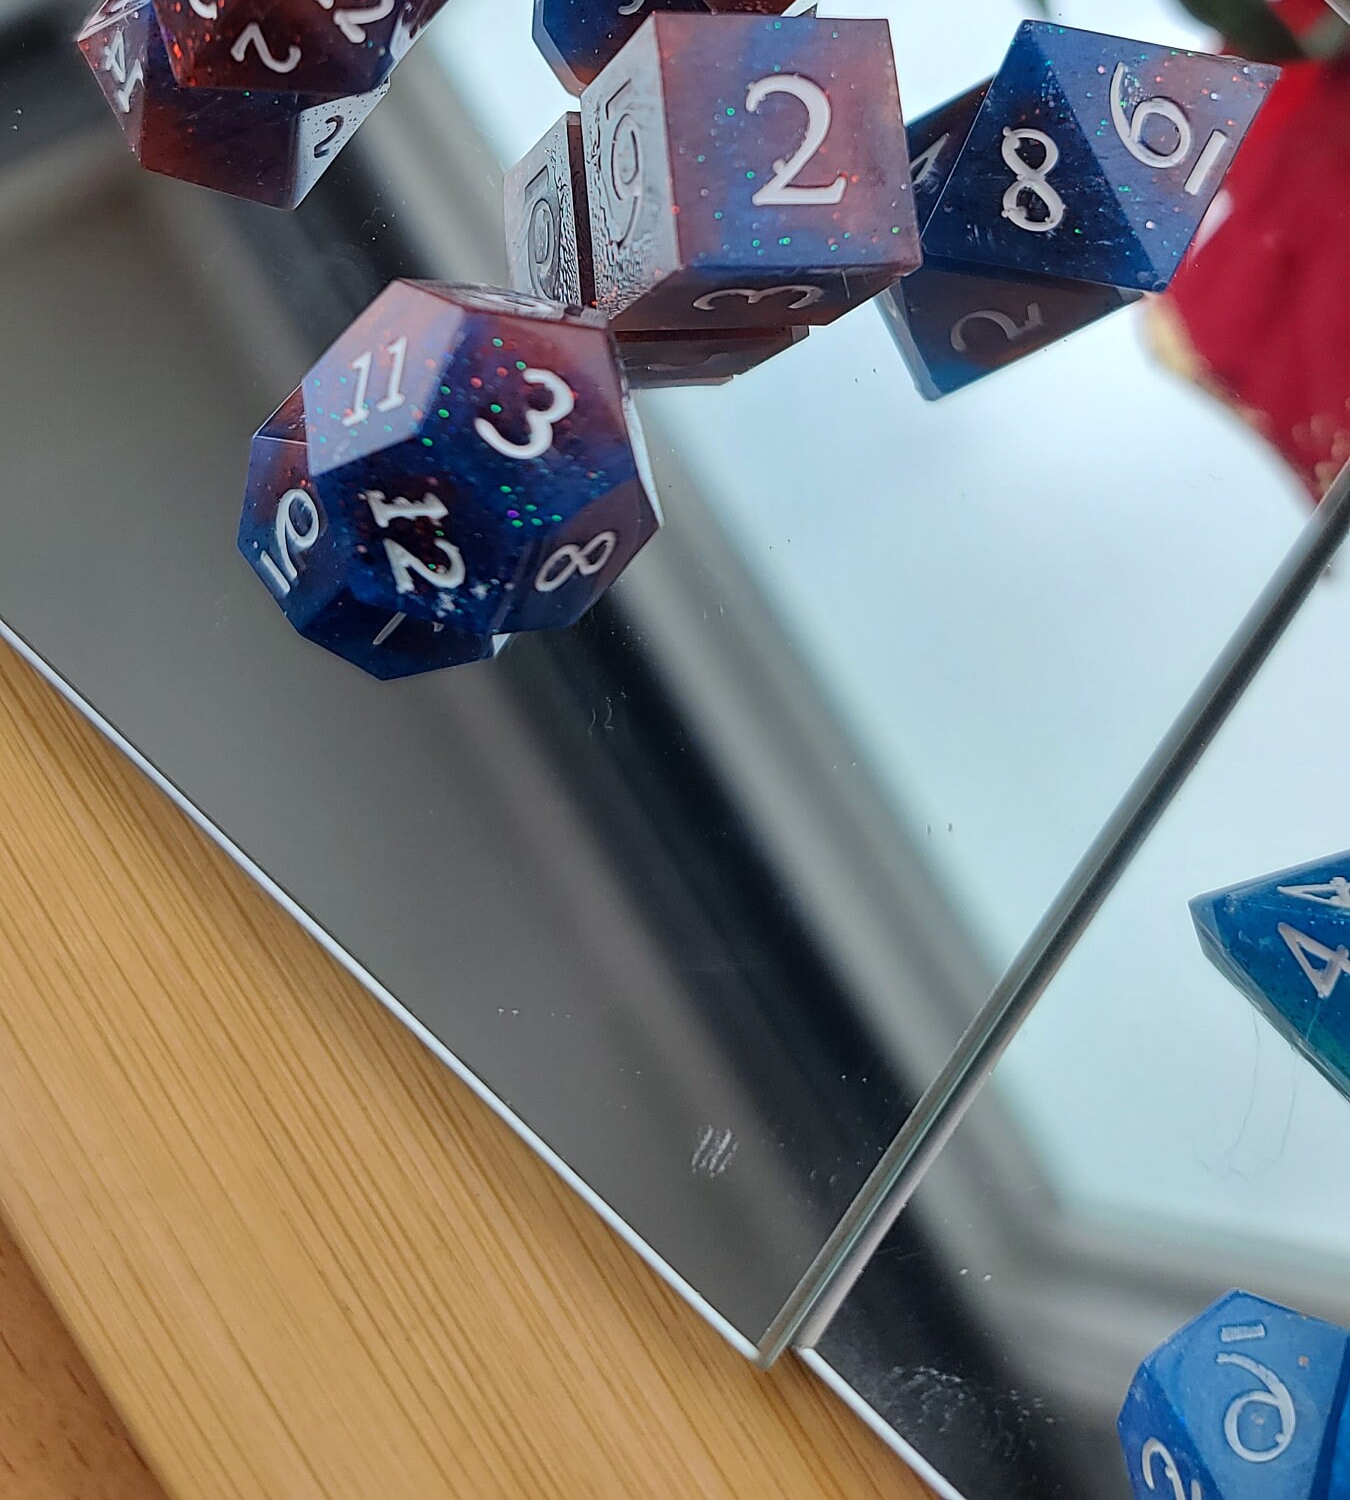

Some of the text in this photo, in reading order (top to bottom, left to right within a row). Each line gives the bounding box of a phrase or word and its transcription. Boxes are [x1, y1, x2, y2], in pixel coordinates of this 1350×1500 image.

[230, 22, 301, 74] 2
[745, 71, 849, 206] 2
[1001, 126, 1066, 233] 8
[342, 336, 408, 427] 11
[474, 368, 575, 460] 3
[357, 489, 467, 594] 12
[534, 530, 617, 593] 8
